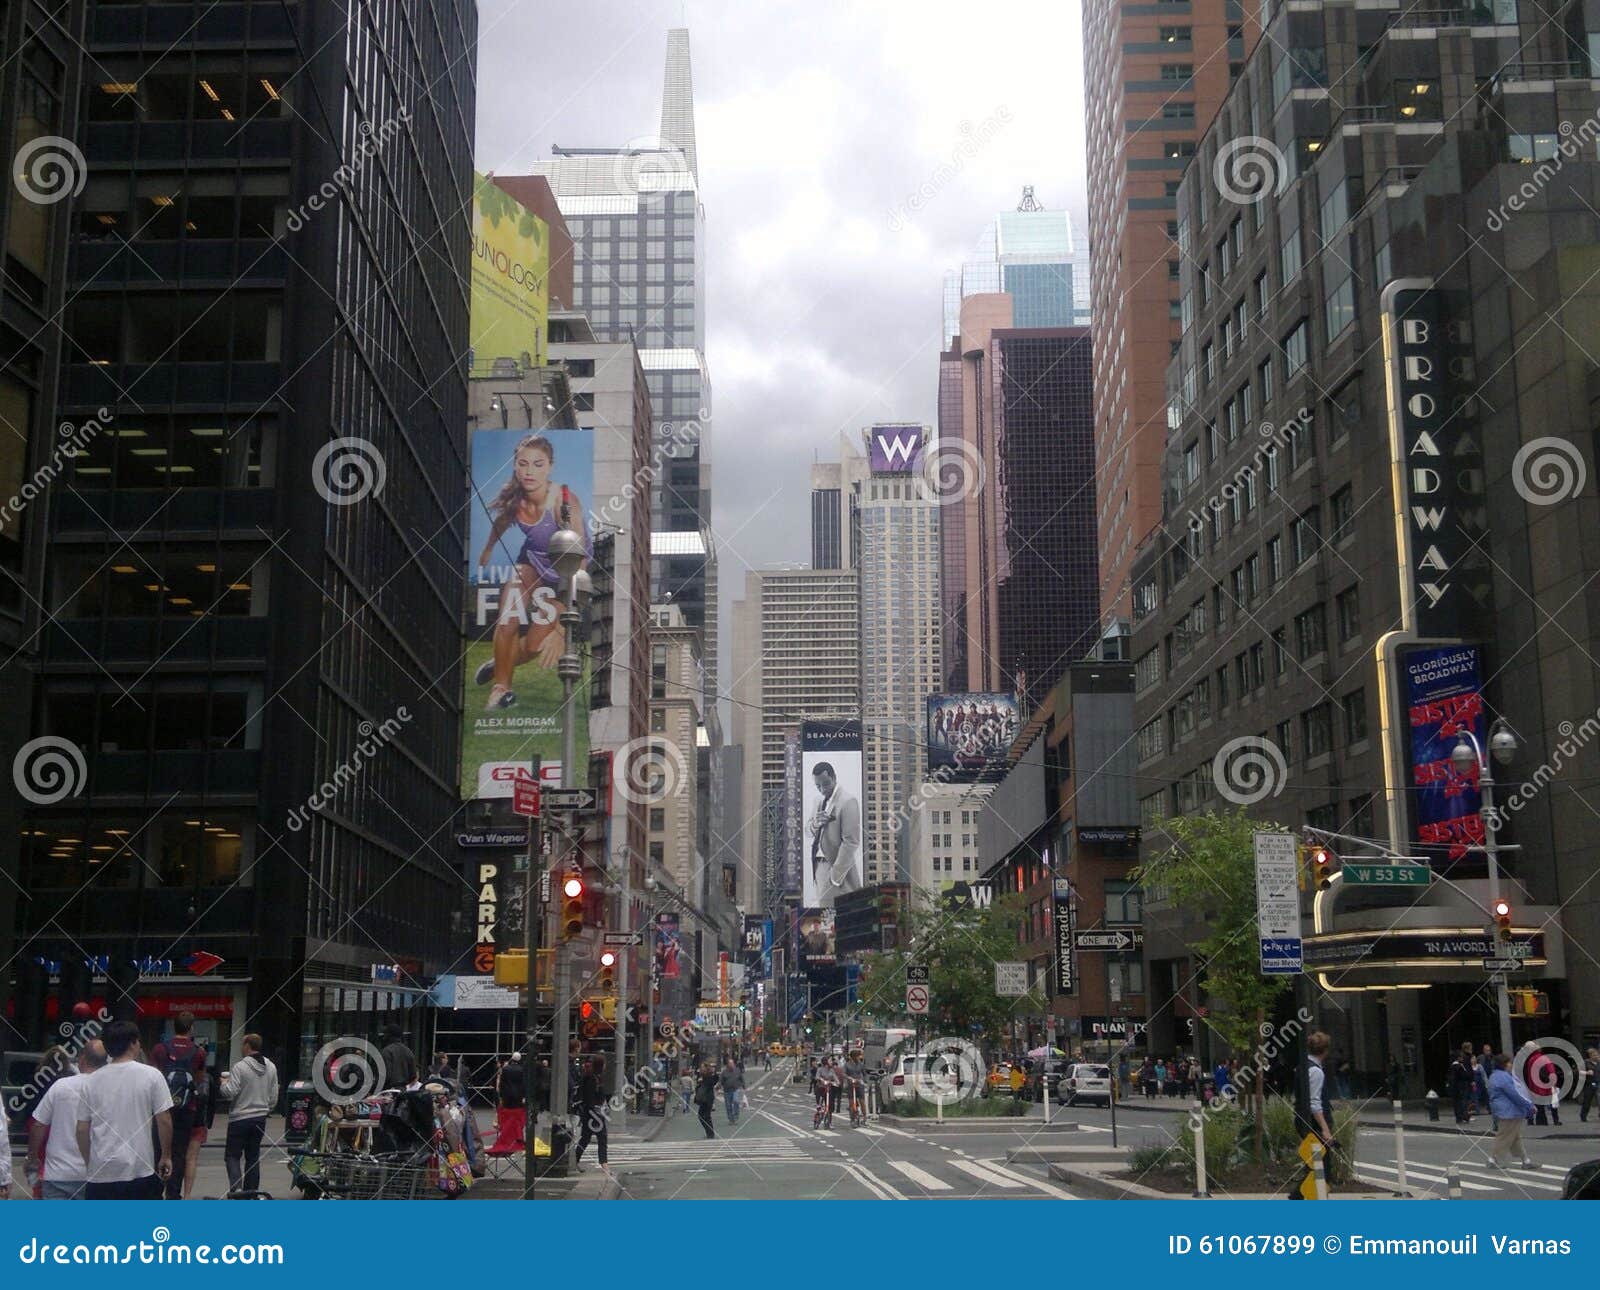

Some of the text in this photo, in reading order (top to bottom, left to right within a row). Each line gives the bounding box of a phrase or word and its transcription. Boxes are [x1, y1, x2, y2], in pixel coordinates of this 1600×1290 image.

[878, 435, 917, 463] W
[1403, 319, 1450, 609] BROADWAY
[477, 565, 523, 584] LIVE
[476, 587, 557, 626] FAS
[1409, 650, 1475, 674] GLORIOUSLY
[1414, 661, 1474, 685] BROADWAY
[474, 716, 556, 728] ALEX MORGAN
[491, 766, 562, 782] GNC
[465, 833, 526, 845] Van Wagner
[1358, 869, 1416, 881] W 53 St
[477, 864, 498, 943] PARK
[1082, 934, 1128, 945] ONE WAY
